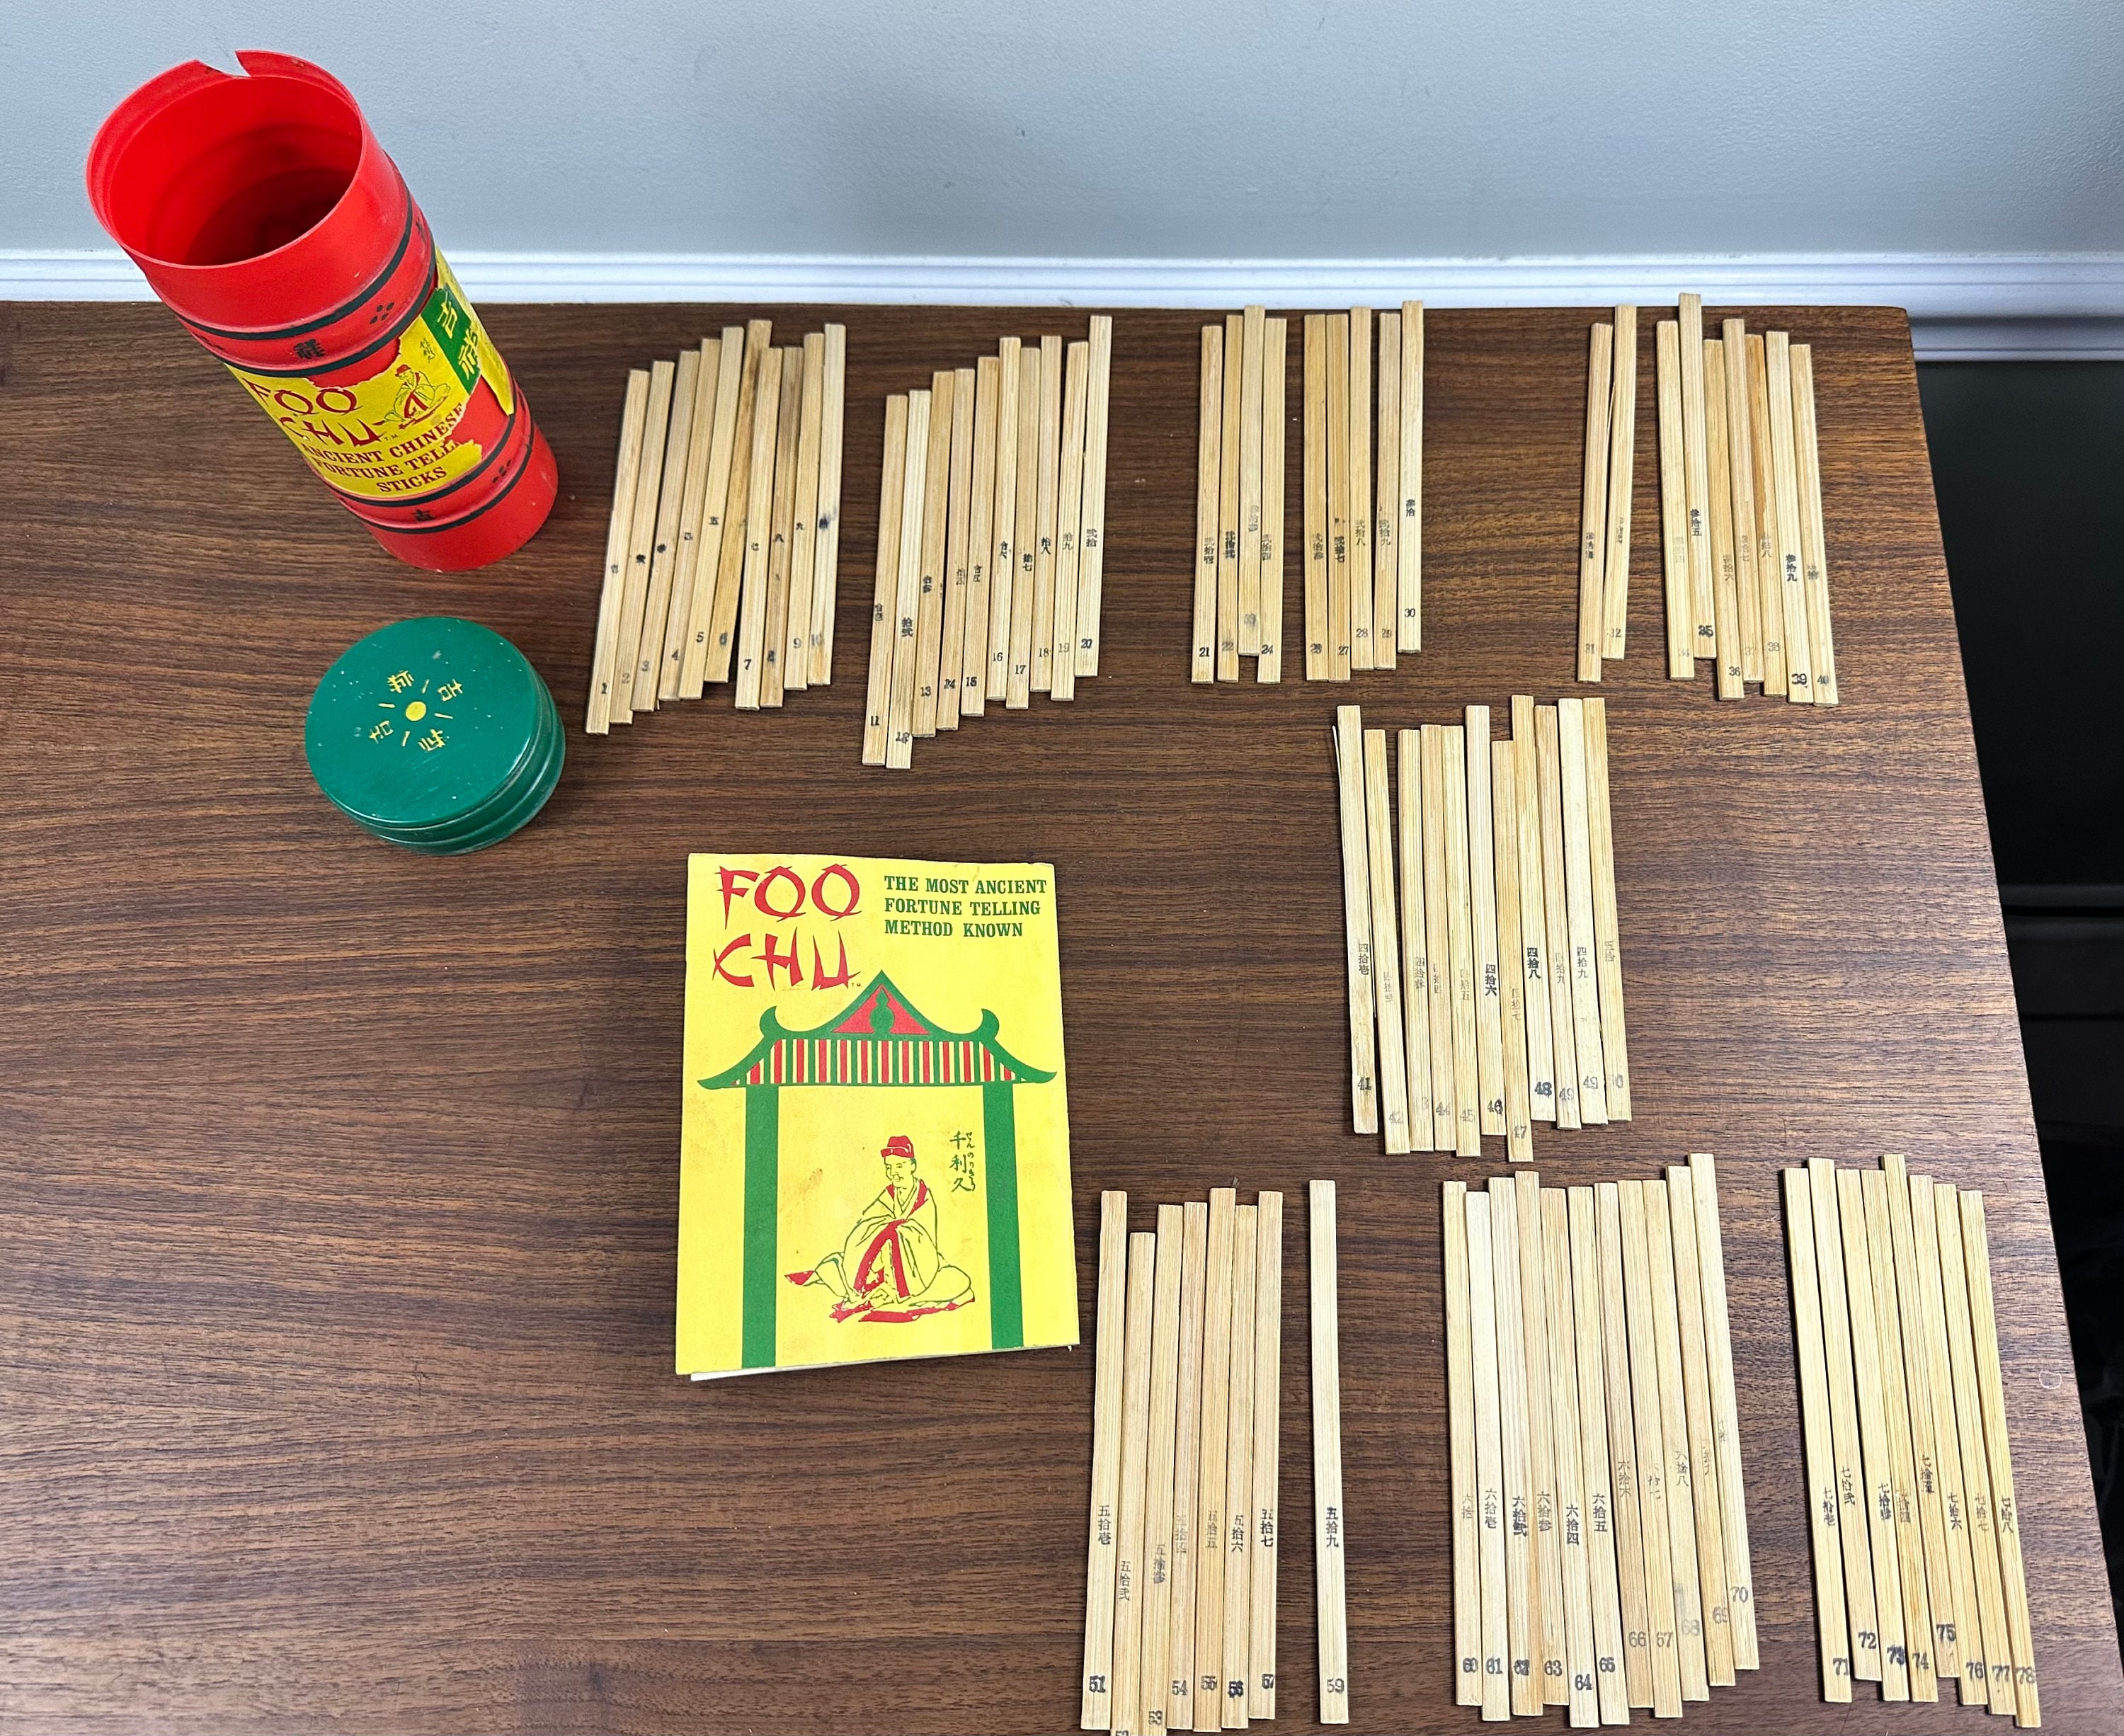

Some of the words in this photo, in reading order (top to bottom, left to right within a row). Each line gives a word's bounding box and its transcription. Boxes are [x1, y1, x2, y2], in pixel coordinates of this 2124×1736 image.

[242, 377, 364, 415] FOO
[301, 443, 382, 464] ANCIENT
[389, 403, 464, 458] CHINESE
[376, 465, 447, 493] STICKS
[773, 533, 784, 543] 八
[1041, 537, 1051, 555] 拾八
[1405, 609, 1415, 617] 30
[696, 632, 704, 643] 5
[1356, 629, 1368, 638] 28
[1698, 625, 1713, 637] 35
[794, 638, 801, 648] 9
[1058, 643, 1070, 653] 19
[1222, 642, 1234, 651] 22
[1262, 645, 1273, 655] 24
[1338, 646, 1349, 656] 27
[1767, 642, 1779, 651] 38
[672, 649, 679, 661] 4
[993, 653, 1003, 661] 16
[1039, 648, 1049, 658] 18
[1199, 647, 1209, 657] 21
[641, 661, 649, 672] 3
[744, 659, 752, 670] 7
[1015, 666, 1025, 675] 17
[1729, 666, 1740, 676] 36
[1792, 673, 1808, 687] 39
[1817, 675, 1829, 685] 40
[920, 687, 931, 697] 13
[884, 876, 918, 891] THE
[925, 878, 969, 893] MOST
[975, 879, 1047, 894] ANCIENT
[716, 864, 862, 930] FOO
[884, 897, 963, 915] FORTUNE
[969, 901, 1041, 915] TELLING
[884, 920, 953, 937] METHOD
[963, 923, 1023, 937] KNOWN
[712, 926, 862, 992] CHU
[1527, 947, 1541, 979] 四拾八
[1577, 947, 1588, 979] 四拾九
[1485, 964, 1497, 996] 四拾六
[1357, 1077, 1371, 1091] 41
[1534, 1082, 1553, 1096] 48
[1583, 1075, 1598, 1089] 49
[1559, 1087, 1575, 1100] 49
[1487, 1100, 1503, 1116] 46
[949, 1131, 971, 1192] 千利久
[1592, 1493, 1607, 1532] 六拾五
[1948, 1492, 1962, 1530] 七拾六
[2001, 1497, 2014, 1534] 七拾八
[1260, 1509, 1274, 1548] 五拾七
[1325, 1507, 1339, 1548] 五拾九
[1565, 1504, 1580, 1546] 六拾四
[1231, 1515, 1244, 1552] 五拾六
[1730, 1587, 1749, 1602] 70
[1713, 1606, 1729, 1624] 69
[1629, 1631, 1647, 1647] 66
[1656, 1631, 1673, 1648] 67
[1858, 1632, 1877, 1649] 72
[1936, 1624, 1955, 1642] 75
[1887, 1645, 1906, 1665] 73
[1912, 1653, 1929, 1670] 74
[1463, 1657, 1478, 1672] 60
[1486, 1658, 1502, 1674] 61
[1545, 1660, 1563, 1676] 63
[1599, 1657, 1615, 1672] 65
[1832, 1658, 1849, 1676] 71
[1966, 1662, 1983, 1681] 76
[1992, 1665, 2011, 1682] 77
[2016, 1667, 2036, 1684] 78
[1089, 1675, 1106, 1693] 51
[1172, 1680, 1188, 1695] 54
[1327, 1678, 1344, 1694] 59
[1575, 1674, 1592, 1691] 64
